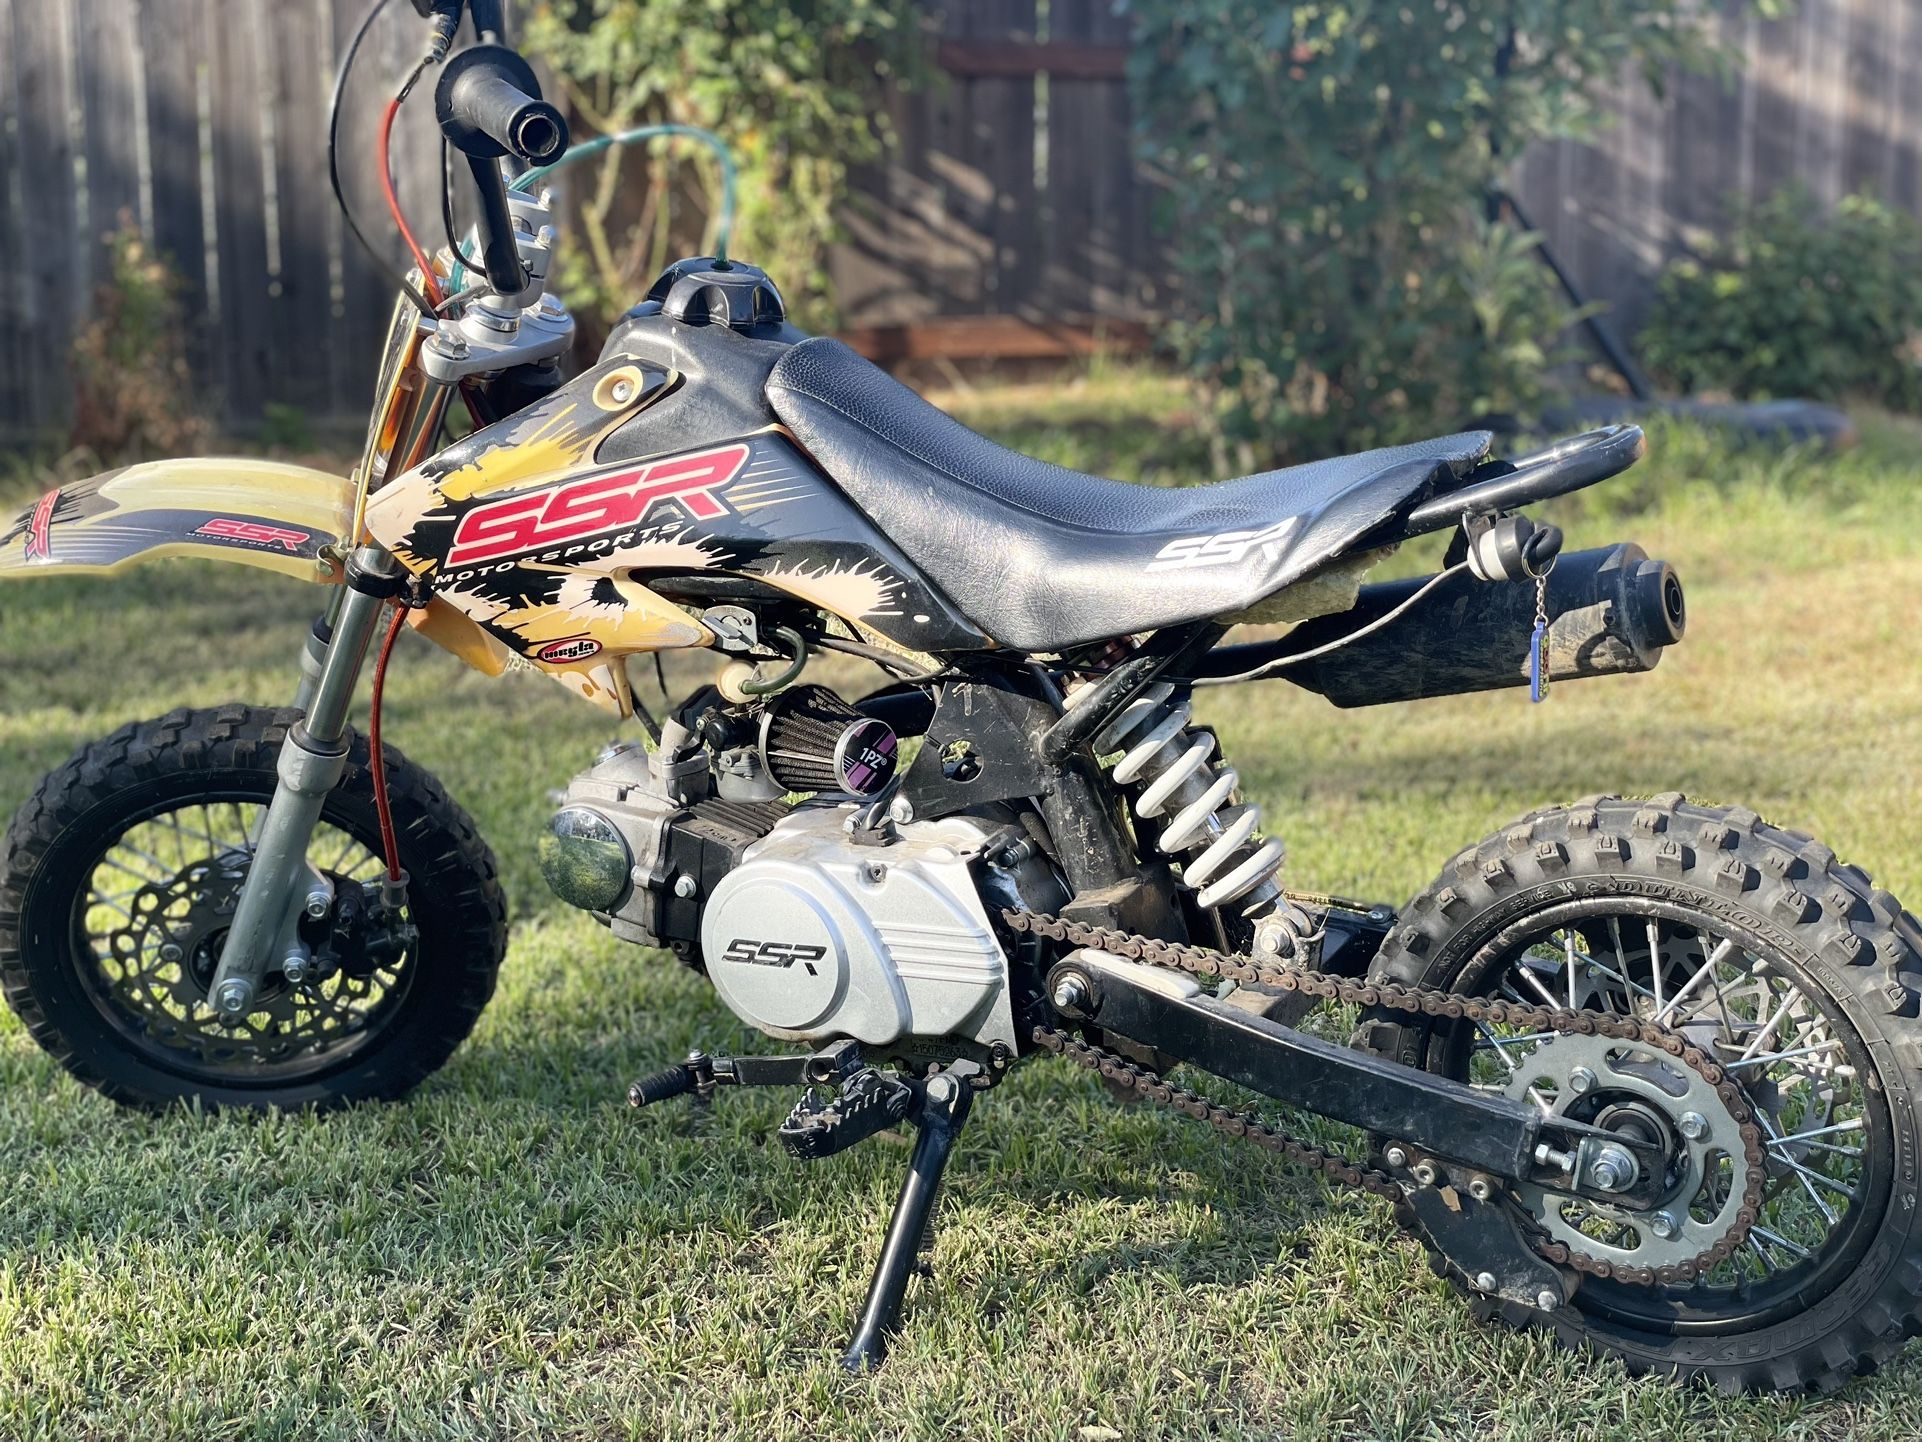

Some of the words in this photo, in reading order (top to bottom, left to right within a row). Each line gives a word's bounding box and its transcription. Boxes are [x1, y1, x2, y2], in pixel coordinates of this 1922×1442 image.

[443, 443, 751, 569] SSR
[185, 531, 283, 549] MOTORSPORTS
[195, 518, 310, 551] SSR
[433, 520, 684, 585] MOTORSPORTS
[1144, 516, 1298, 572] SSR
[721, 938, 828, 977] SSR
[1454, 934, 1473, 950] FOR
